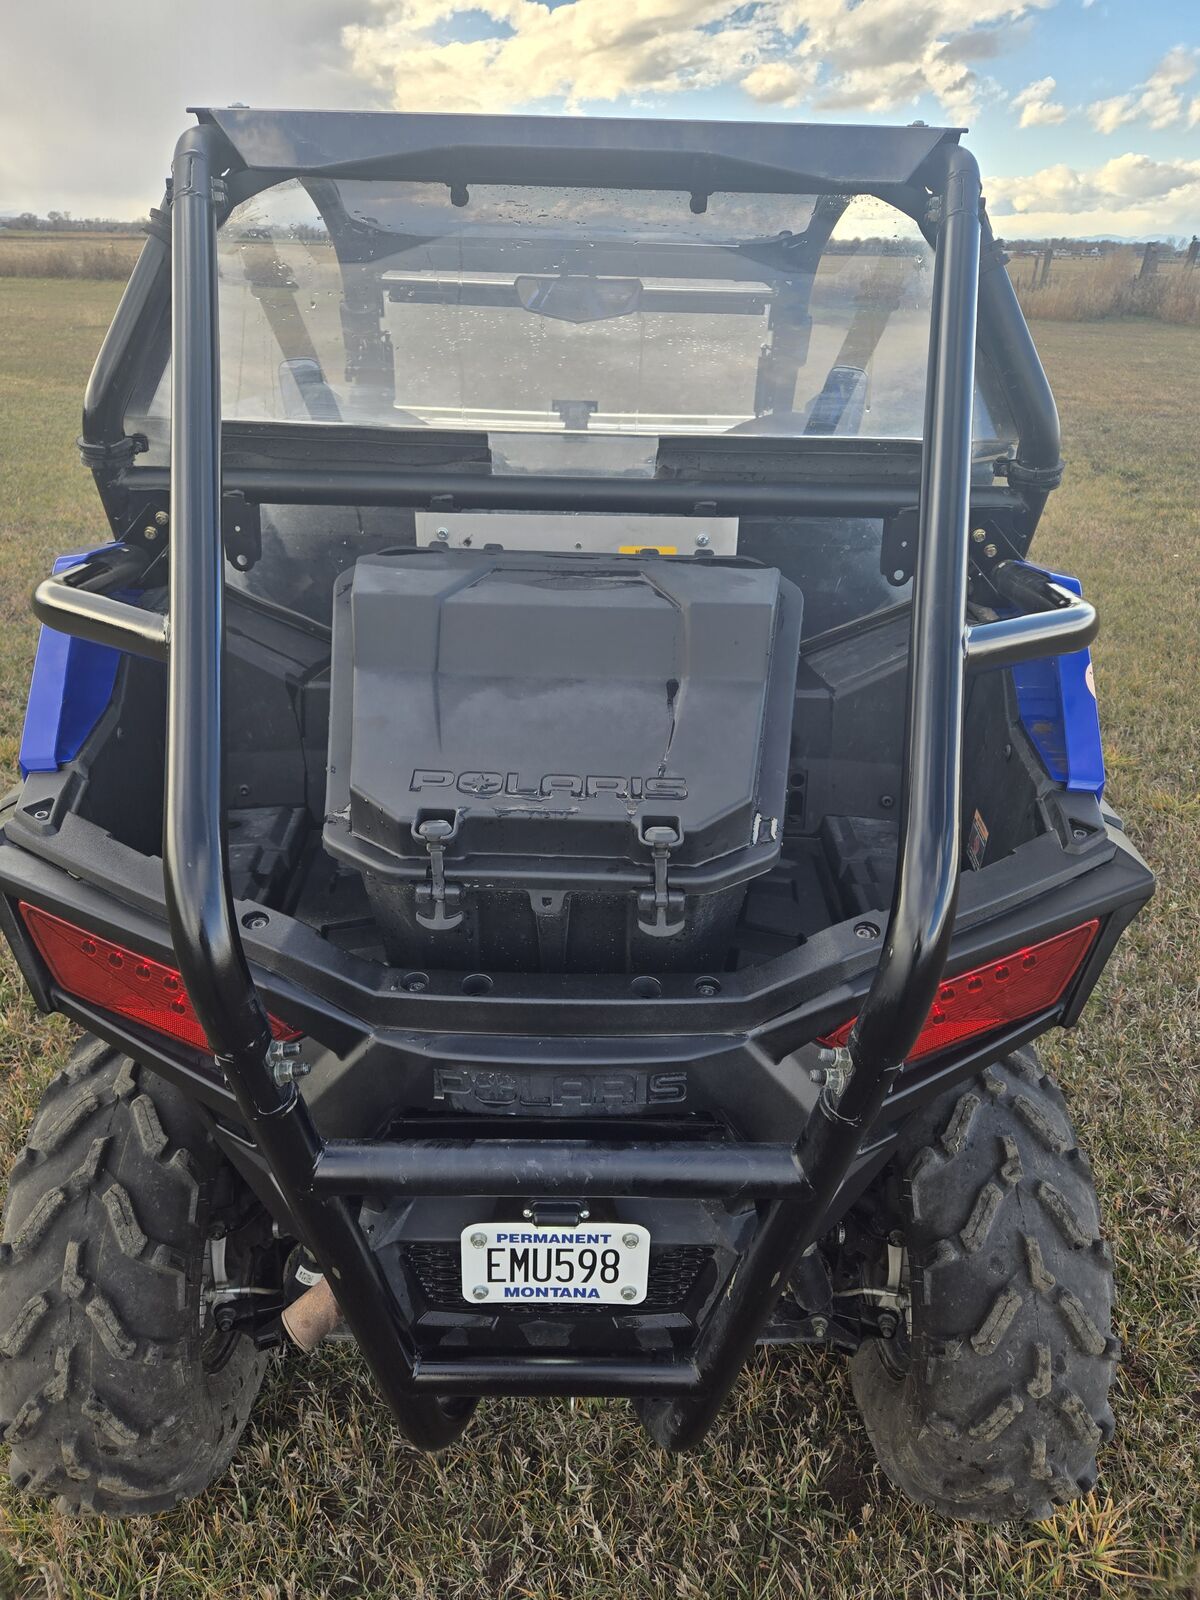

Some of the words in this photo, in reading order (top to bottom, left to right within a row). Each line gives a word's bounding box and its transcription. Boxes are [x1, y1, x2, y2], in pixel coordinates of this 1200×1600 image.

[409, 768, 688, 800] POLARIS
[433, 1068, 688, 1106] POLARIS
[496, 1233, 612, 1244] PERMANENT
[486, 1248, 620, 1283] EMU598
[504, 1287, 600, 1298] MONTANA
